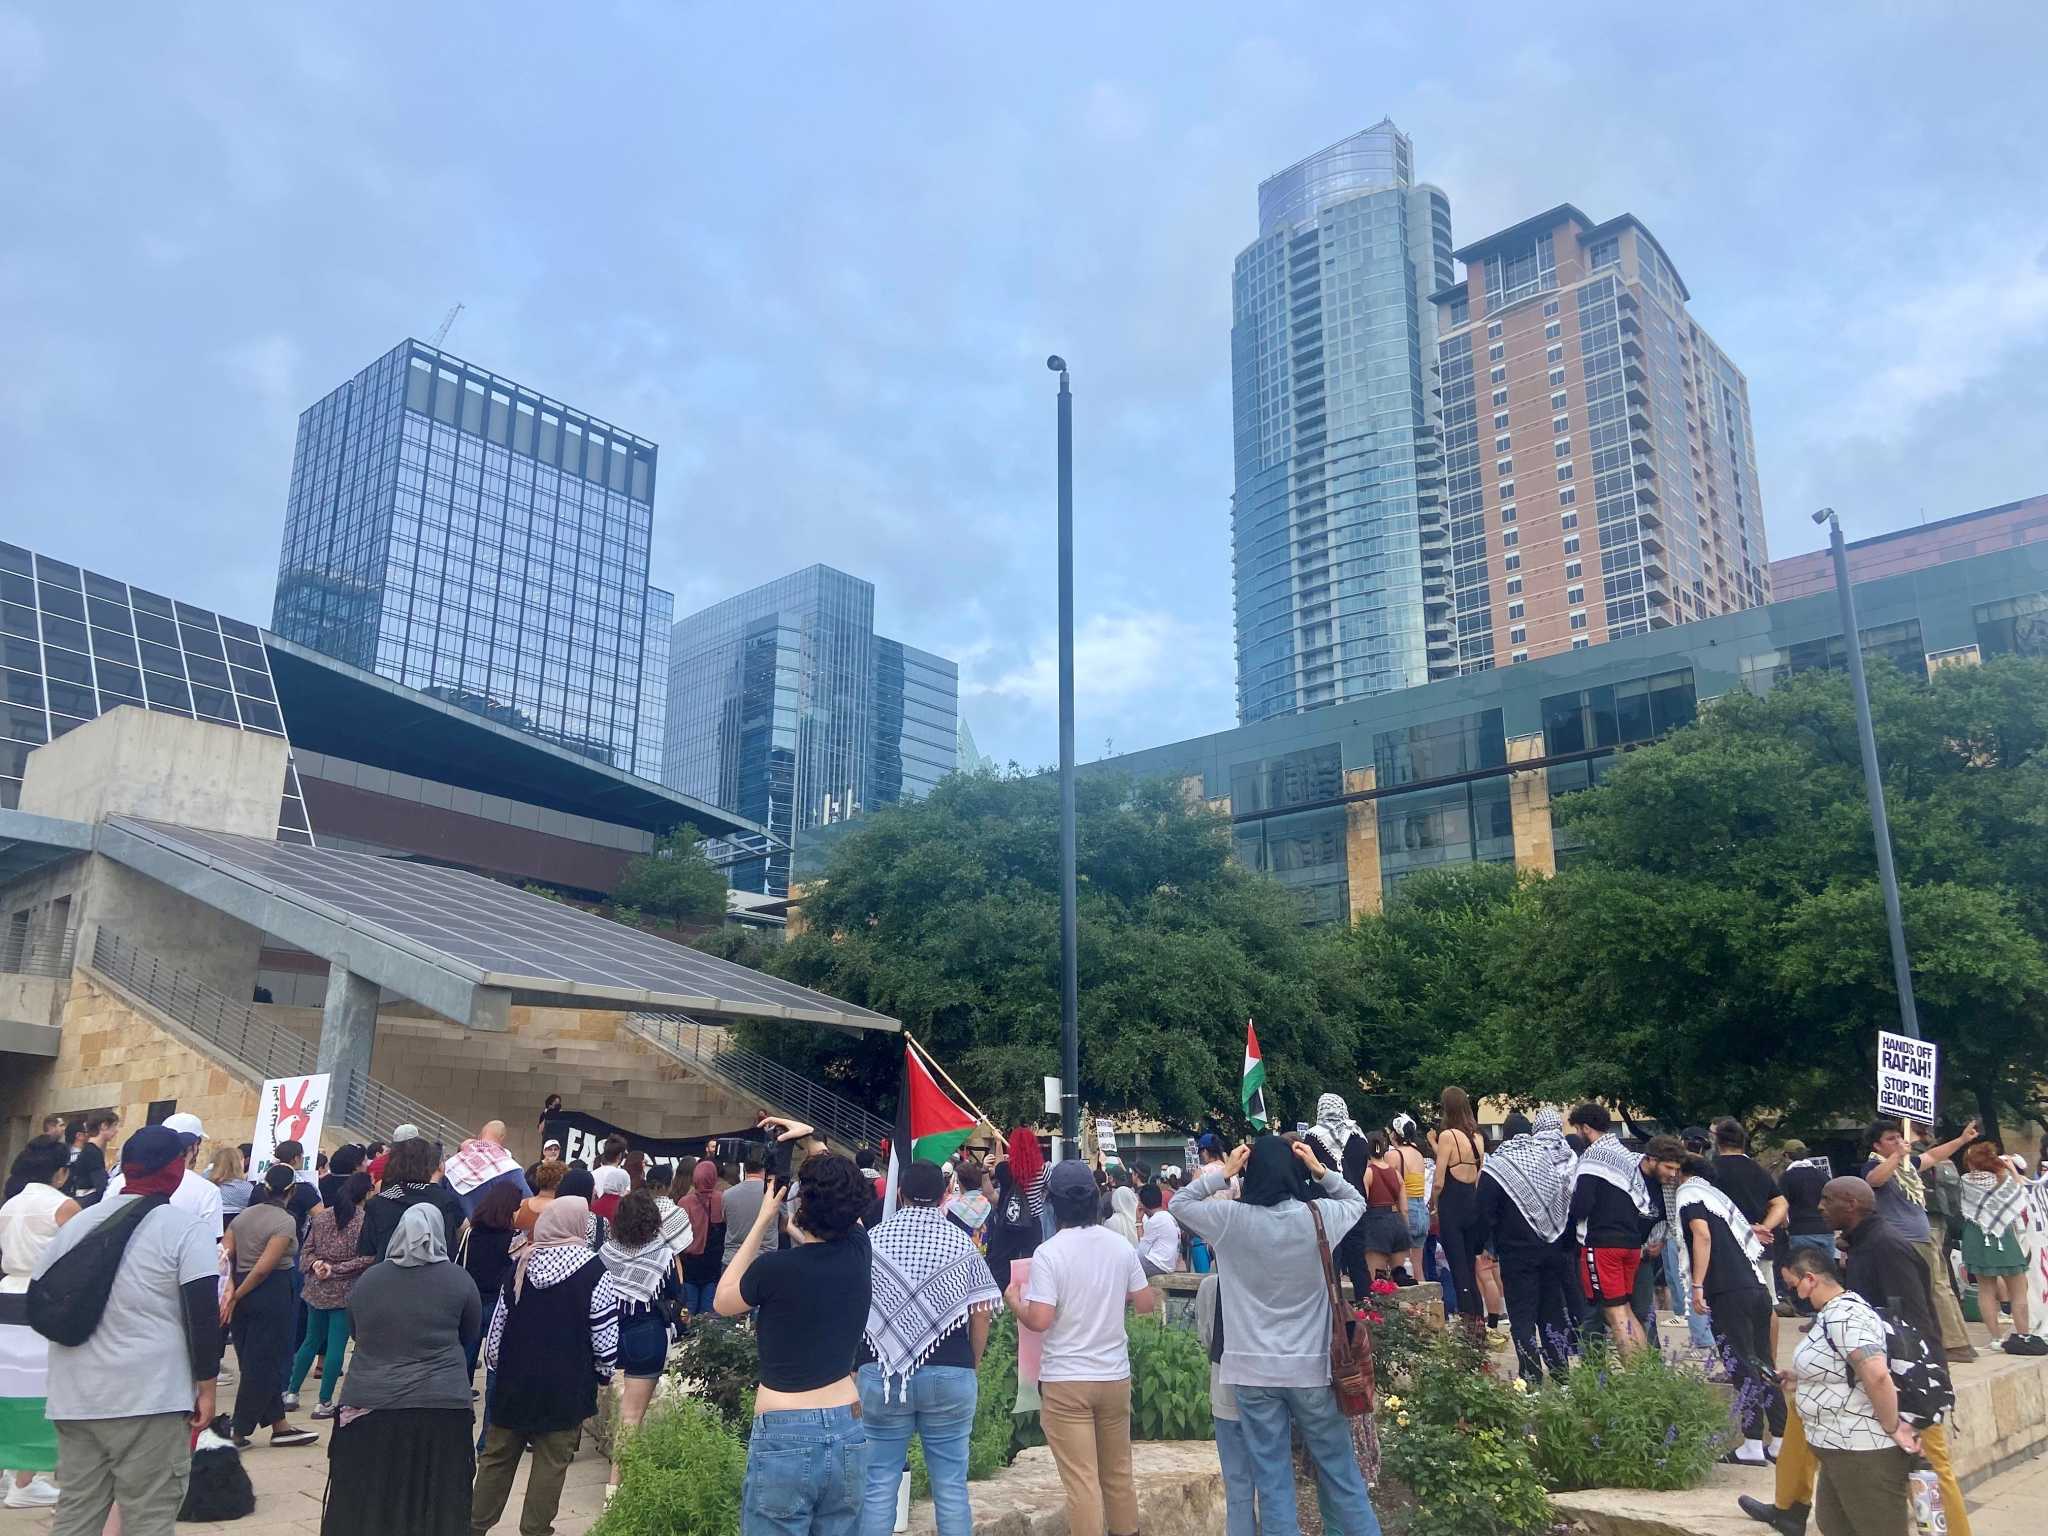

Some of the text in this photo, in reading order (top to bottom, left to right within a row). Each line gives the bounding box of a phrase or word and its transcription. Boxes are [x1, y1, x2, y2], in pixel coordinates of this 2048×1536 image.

[1882, 1036, 1932, 1060] HANDS OFF
[1881, 1050, 1931, 1079] RAFAH!
[1884, 1076, 1929, 1099] STOP THE
[1880, 1090, 1932, 1115] GENOCIDE!
